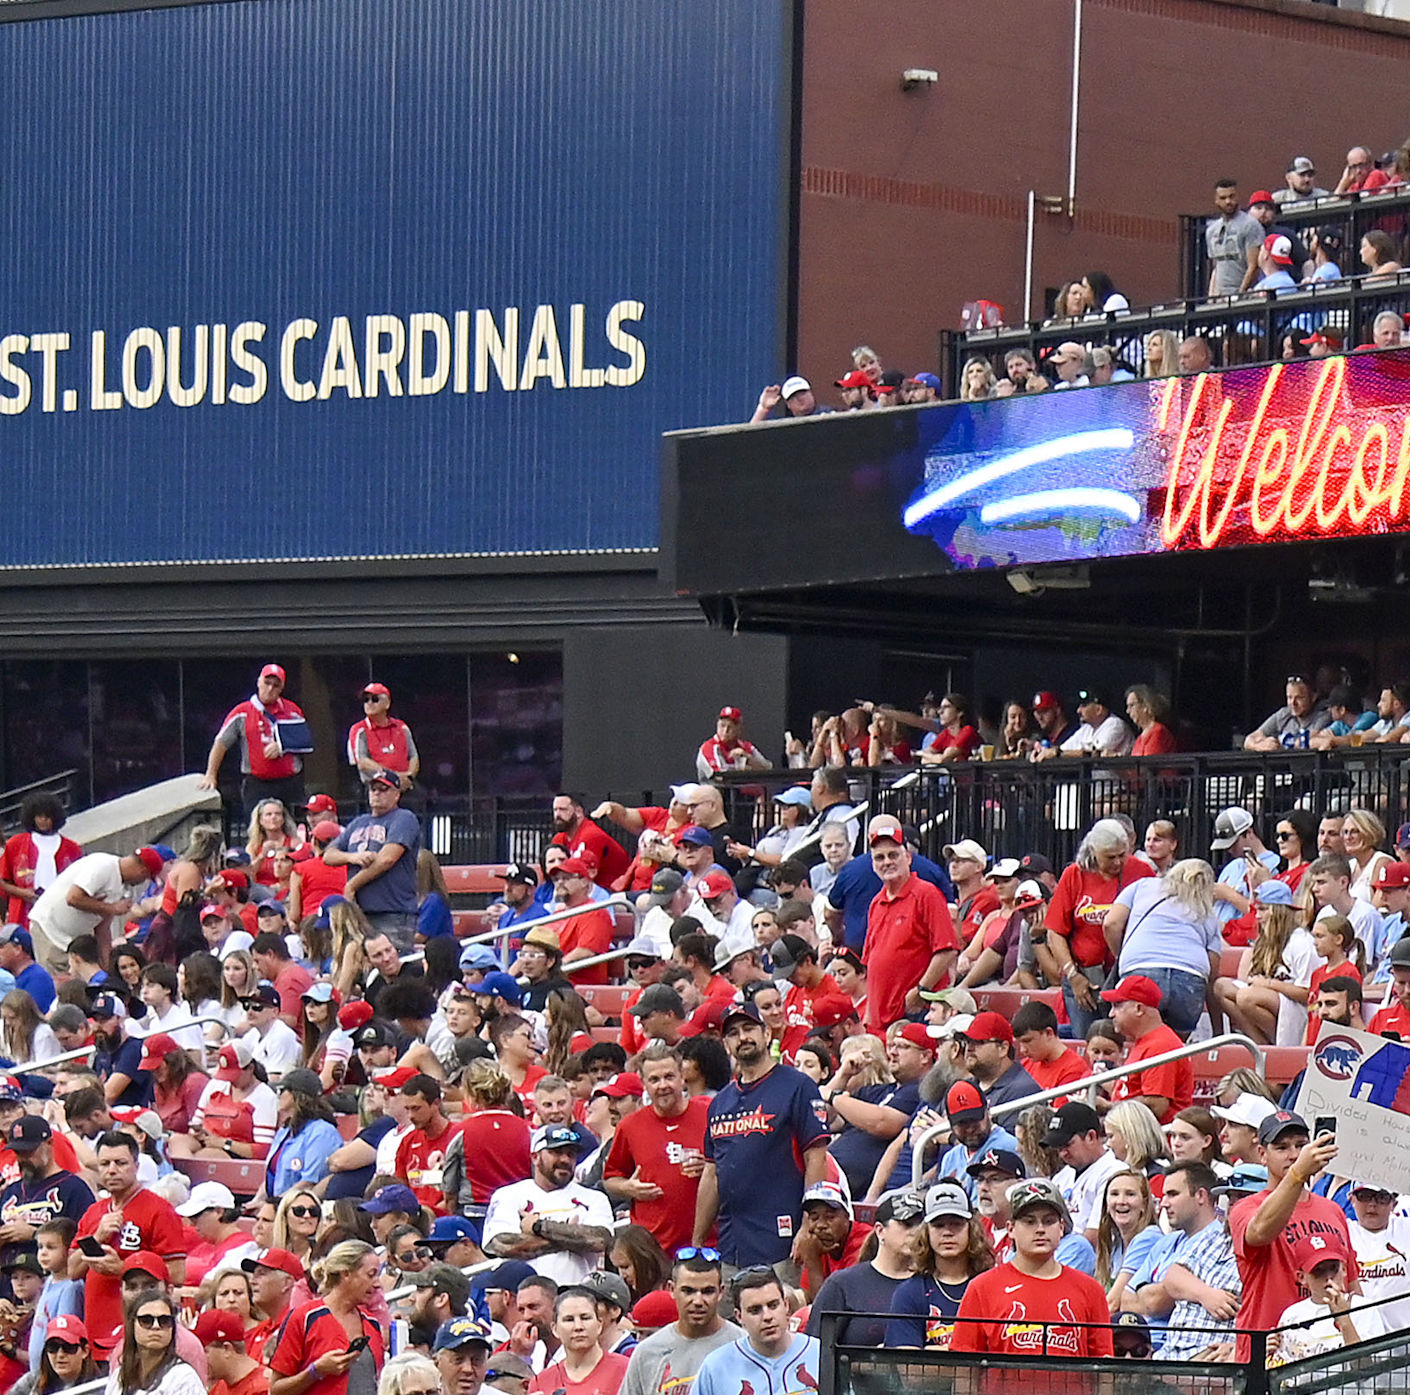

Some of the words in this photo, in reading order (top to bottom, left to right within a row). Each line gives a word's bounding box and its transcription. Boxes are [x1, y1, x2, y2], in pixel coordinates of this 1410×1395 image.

[0, 332, 77, 416] ST.
[91, 321, 267, 410] LOUIS
[280, 300, 647, 402] CARDINALS
[710, 1117, 770, 1139] NATIONAL
